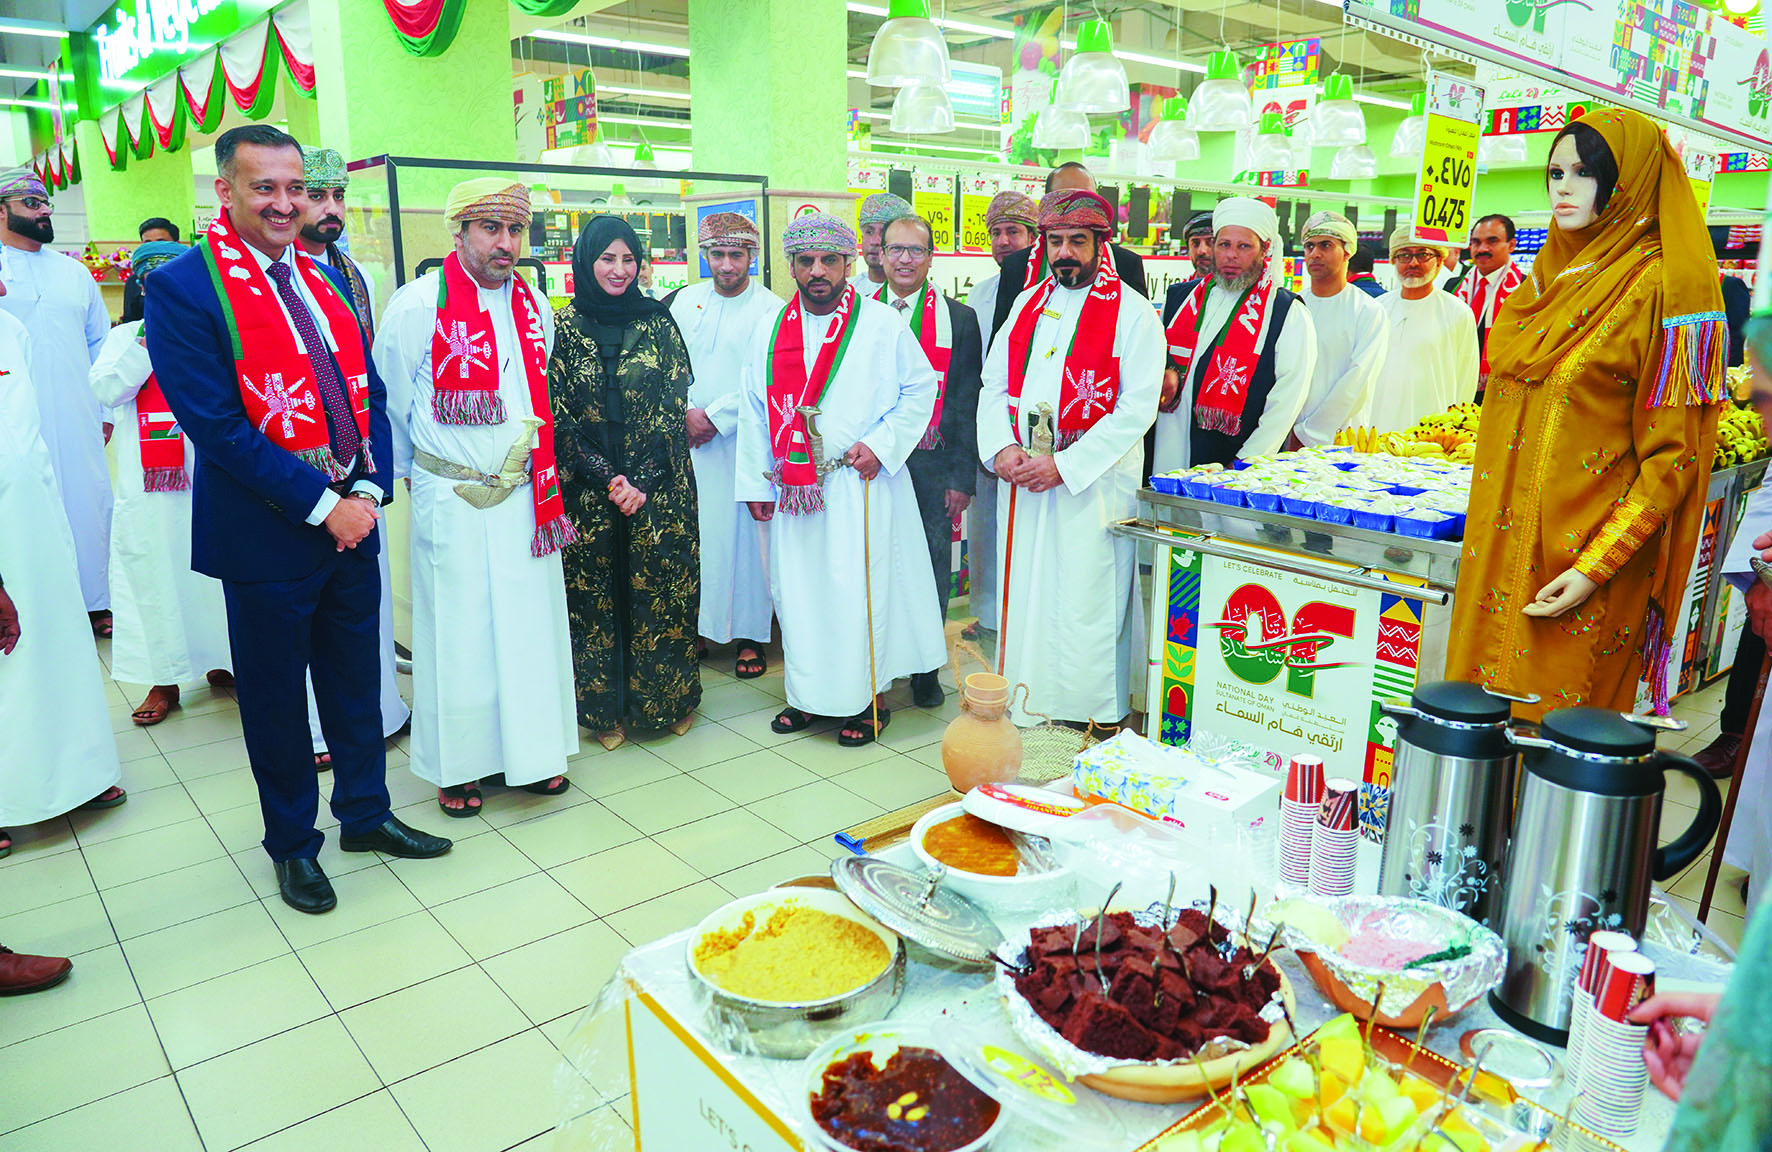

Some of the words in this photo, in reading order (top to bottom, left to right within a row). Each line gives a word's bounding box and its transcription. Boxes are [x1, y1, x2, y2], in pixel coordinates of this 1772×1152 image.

[1423, 194, 1466, 229] 0.475
[1223, 561, 1241, 571] LET'S
[1242, 565, 1283, 580] CELEBRATE
[1216, 680, 1256, 699] NATIONAL
[1257, 693, 1275, 704] DAY
[1256, 702, 1275, 712] OMAN
[699, 1095, 739, 1150] LET'S
